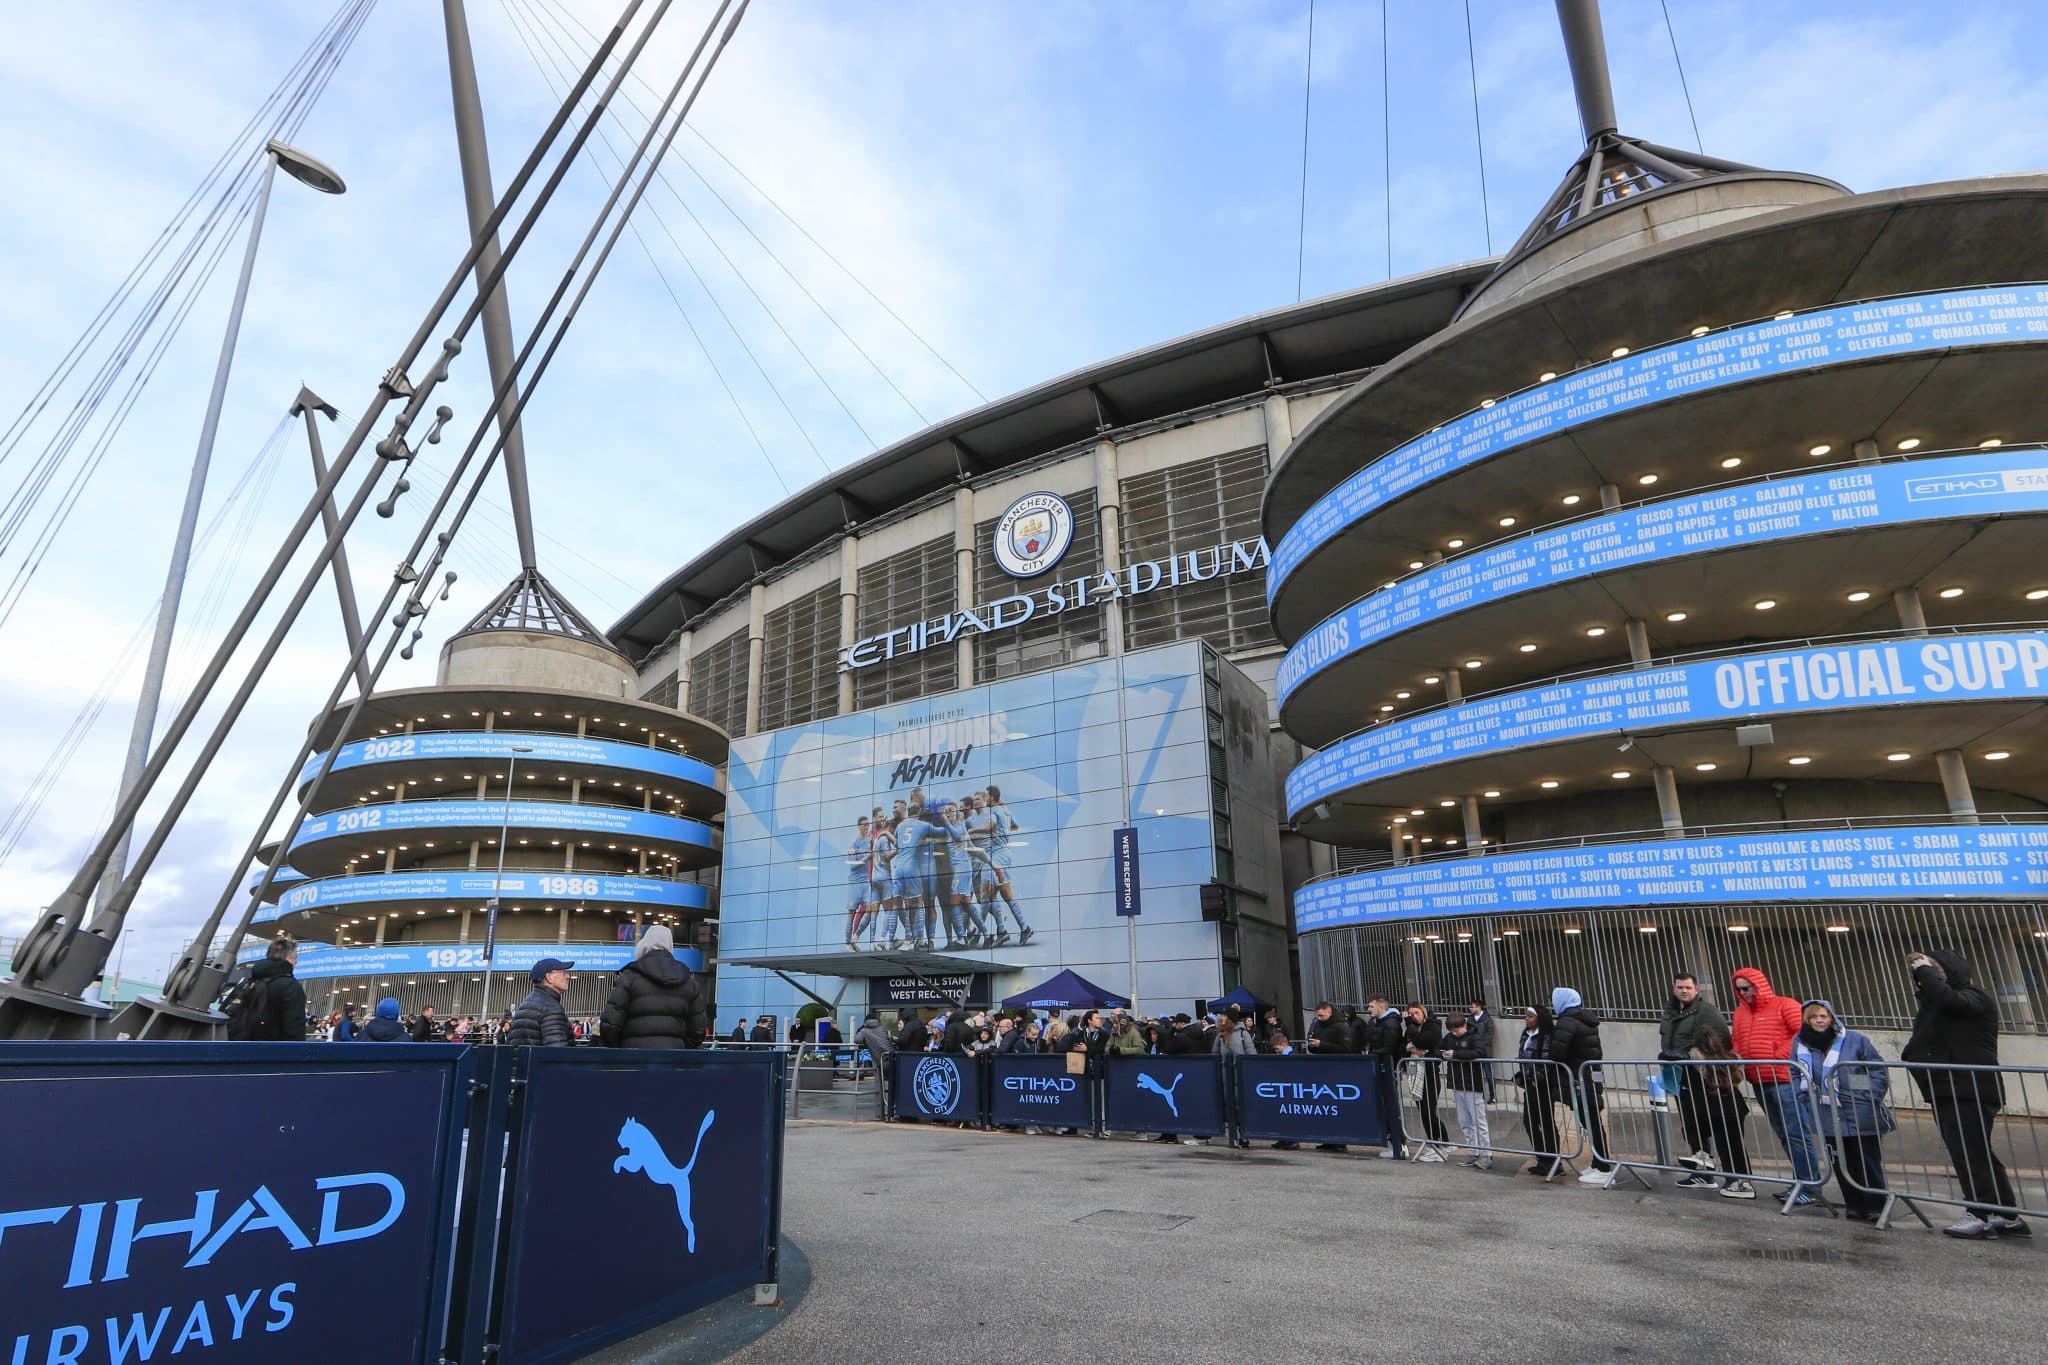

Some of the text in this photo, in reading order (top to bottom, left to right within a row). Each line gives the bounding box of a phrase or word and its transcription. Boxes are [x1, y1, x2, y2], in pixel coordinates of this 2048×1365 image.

[1462, 312, 1973, 446] BROOKS BAR BUCHAREST BUENOS AIRES BULGARIA BURY CAIRO CALGARY CAMARILLO
[1473, 294, 2017, 428] ATLANTA CITYZENS AUDENSHAW AUSTIN BAGULEY & BROOKLANDS BALLYMENA BANGLADESH
[1457, 322, 2008, 460] CHORLEY CINCINNATI CITIZENS BRASIL CITYZENS KERALA CLAYTON CLEVELAND COIMBATORE
[1914, 479, 1998, 494] ETIHAD
[1002, 498, 1063, 571] MANCHESTER CITY
[1482, 489, 1876, 582] CHELTENHAM GOA GORTON GRAND RAPIDS GUANGZHOU BLUE MOON
[1486, 474, 1872, 566] FRANCE FRESNO CITYZENS FRISCO SKY BLUES GALWAY GELEEN
[1436, 504, 1878, 610] GUERNSEY GUIYANG HALE ALTRINCHAM HALIFAX & DISTRICT HALTON
[847, 535, 1271, 669] ETIHAD STADIUM
[1308, 617, 1349, 668] CLUBS
[1714, 638, 2048, 710] OFFICIAL SUPP
[1447, 686, 1688, 738] SUSSEX BLUES MIDDLETON MILANO BLUE MOON
[1458, 670, 1686, 721] MALLORCA BLUES MALTA MANIPUR CITYZENS
[1454, 700, 1690, 750] MOSSLEY MOUNT MULLINGAR
[364, 740, 416, 760] 2022
[889, 744, 972, 789] AGAIN!
[336, 810, 381, 832] 2012
[903, 827, 912, 843] 5
[1122, 835, 1130, 859] WEST
[1452, 832, 2018, 878] REDDISH REDONDO BEACH BLUES ROSE CITY SKY BLUES RUSHOLME & MOSS SIDE SABAH SAINT
[432, 886, 448, 894] Cup
[538, 876, 599, 896] 1986
[1460, 852, 2008, 892] CITYZENS SOUTH STAFFS SOUTH YORKSHIRE SOUTHPORT & WEST LANCS STALYBRIDGE BLUES
[1464, 870, 2004, 906] CITYZENS TUNIS ULAANBAATAR VANCOUVER WARRINGTON WARWICK & LEAMINGTON
[290, 886, 318, 908] 1970
[498, 950, 512, 958] City
[890, 979, 915, 987] COLIN
[918, 978, 939, 986] BLL
[890, 991, 916, 1000] WEST
[918, 1058, 952, 1114] MANCHESTER CITY
[1004, 1076, 1076, 1092] ETIHAD
[1019, 1094, 1060, 1104] AIRWAYS
[1256, 1082, 1361, 1100] ETIHAD
[1280, 1104, 1338, 1116] AIRWAYS
